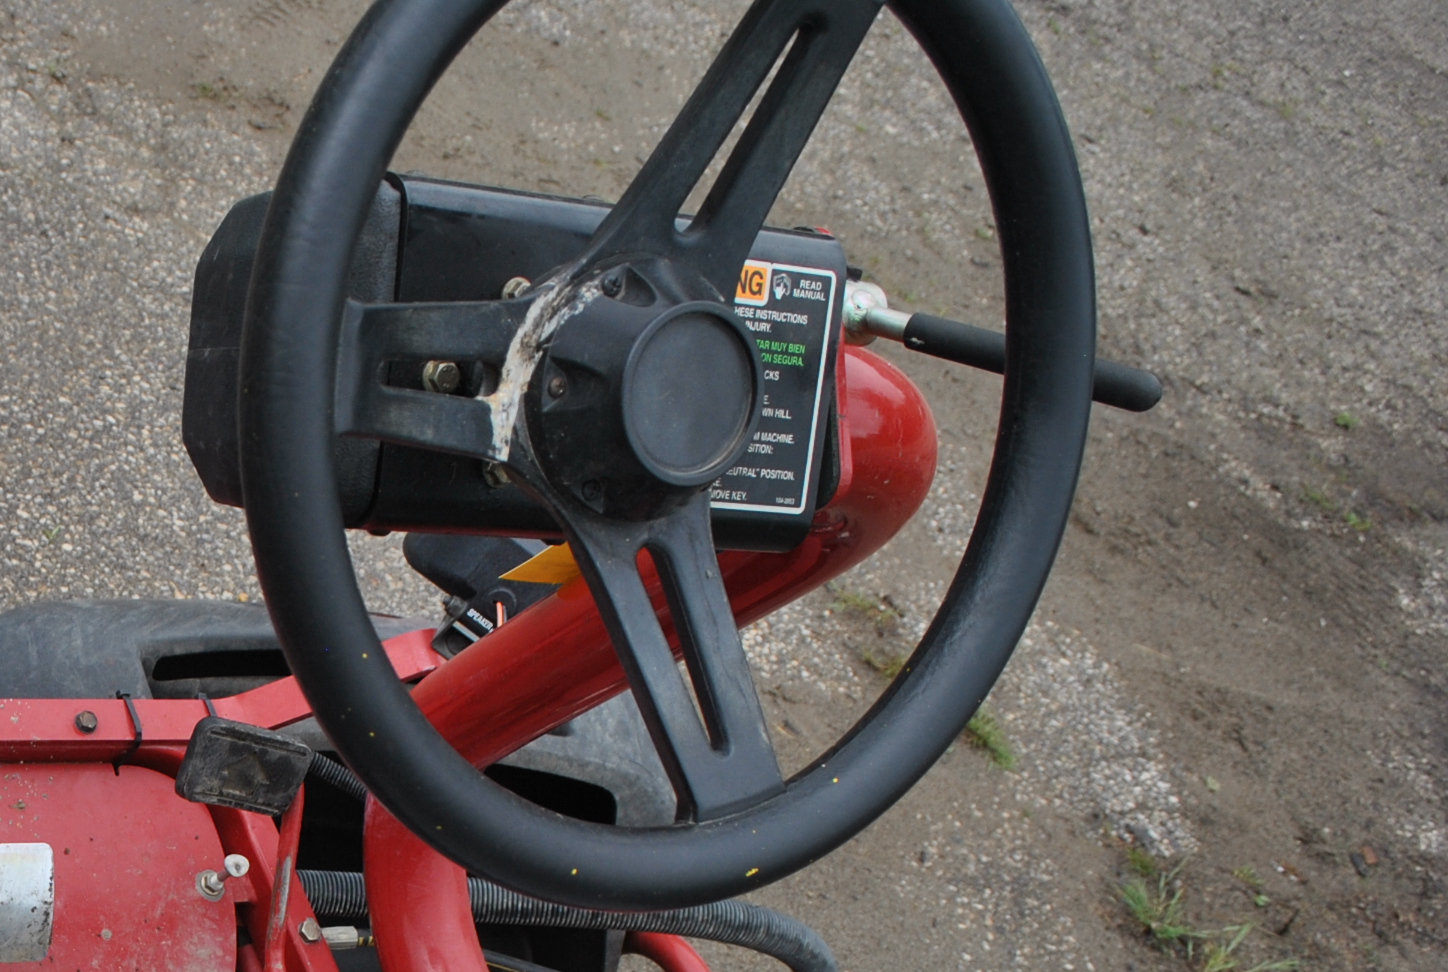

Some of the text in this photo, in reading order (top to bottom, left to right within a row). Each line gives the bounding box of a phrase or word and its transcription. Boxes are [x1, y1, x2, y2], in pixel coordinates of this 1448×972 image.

[800, 279, 822, 291] READ
[793, 288, 826, 301] MANUAL
[755, 308, 808, 325] INSTRUCTIONS
[771, 341, 787, 352] MUY
[788, 343, 806, 354] BIEN
[773, 354, 804, 367] SEGURA.
[761, 432, 795, 444] MACHINE.
[760, 468, 795, 481] POSITION.
[731, 490, 748, 501] KEY.
[466, 607, 494, 631] SPEAKER
